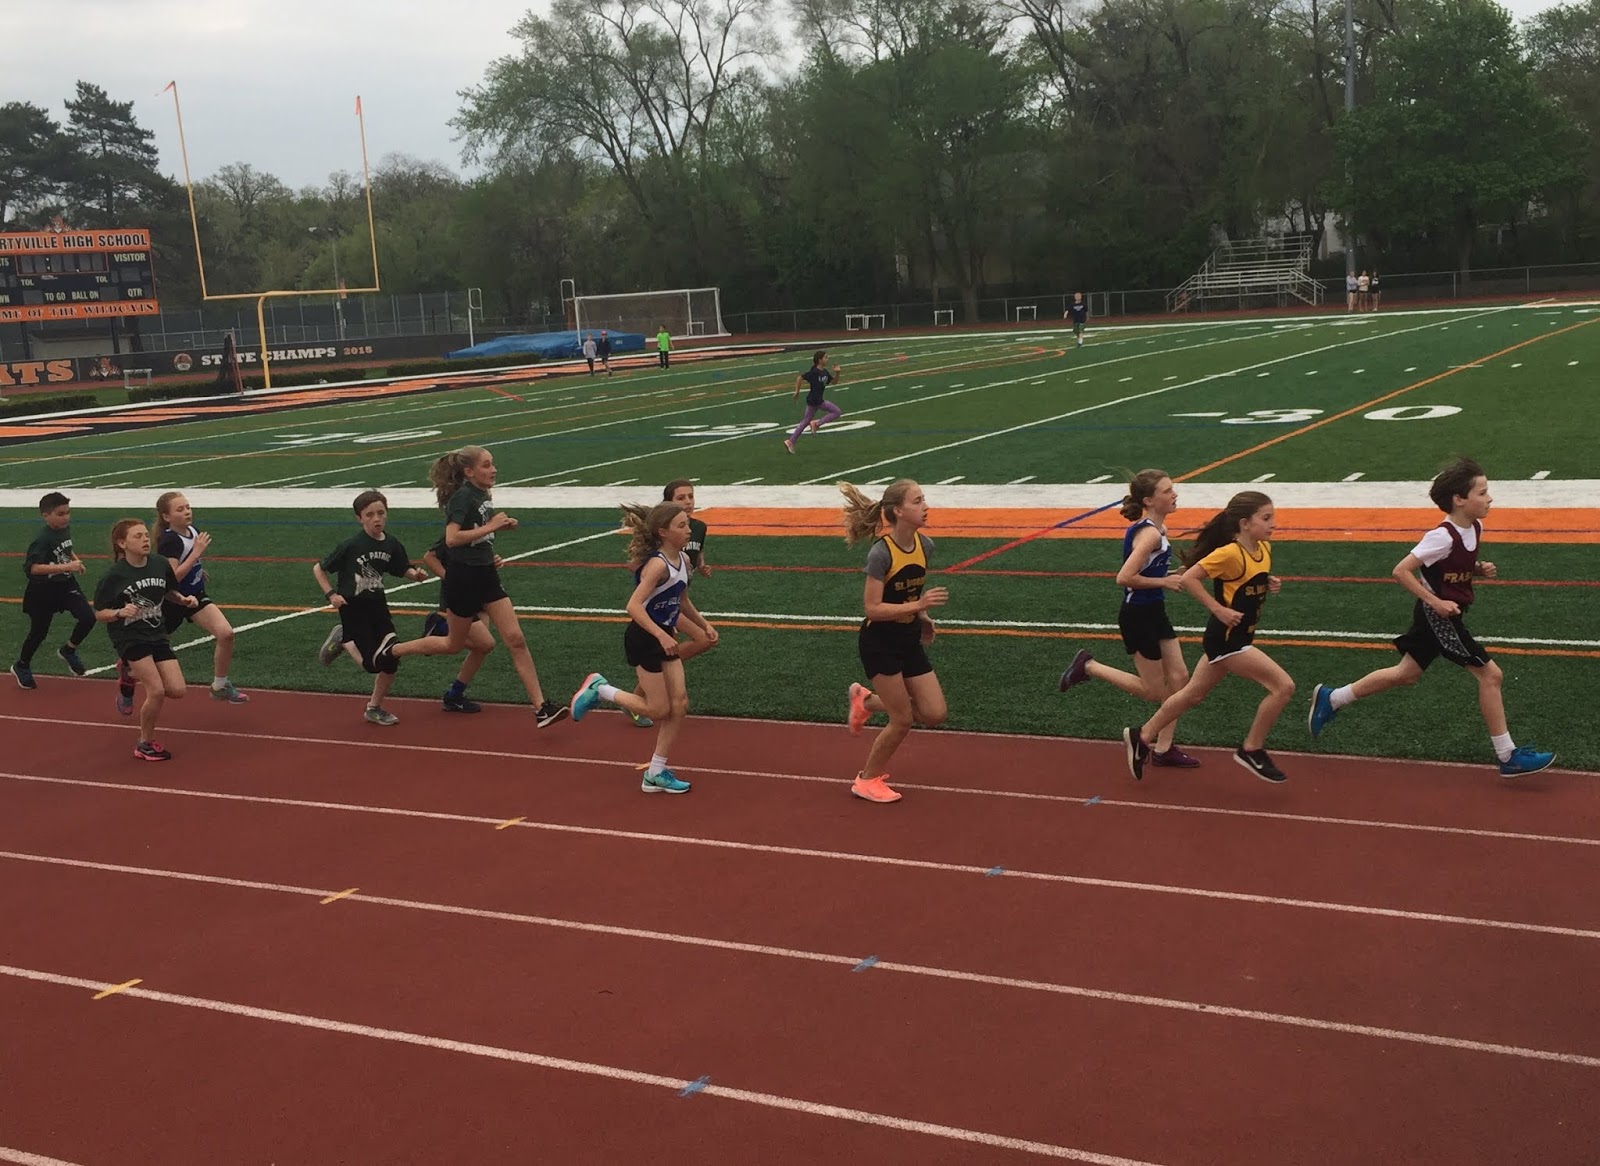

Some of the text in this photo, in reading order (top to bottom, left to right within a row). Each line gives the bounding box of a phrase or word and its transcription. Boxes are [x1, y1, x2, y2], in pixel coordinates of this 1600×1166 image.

[63, 236, 94, 248] HIGH
[98, 234, 147, 248] SCHOOL
[114, 253, 146, 262] VISITOR
[45, 293, 66, 301] TO GO
[72, 290, 99, 301] BALL ON
[128, 288, 142, 297] QTR
[28, 308, 43, 318] OF
[51, 307, 78, 318] THE
[83, 304, 153, 315] WILDCATS
[201, 351, 257, 366] STTE
[261, 346, 337, 361] CHAMPS
[357, 555, 369, 564] ST.
[123, 585, 137, 595] ST.
